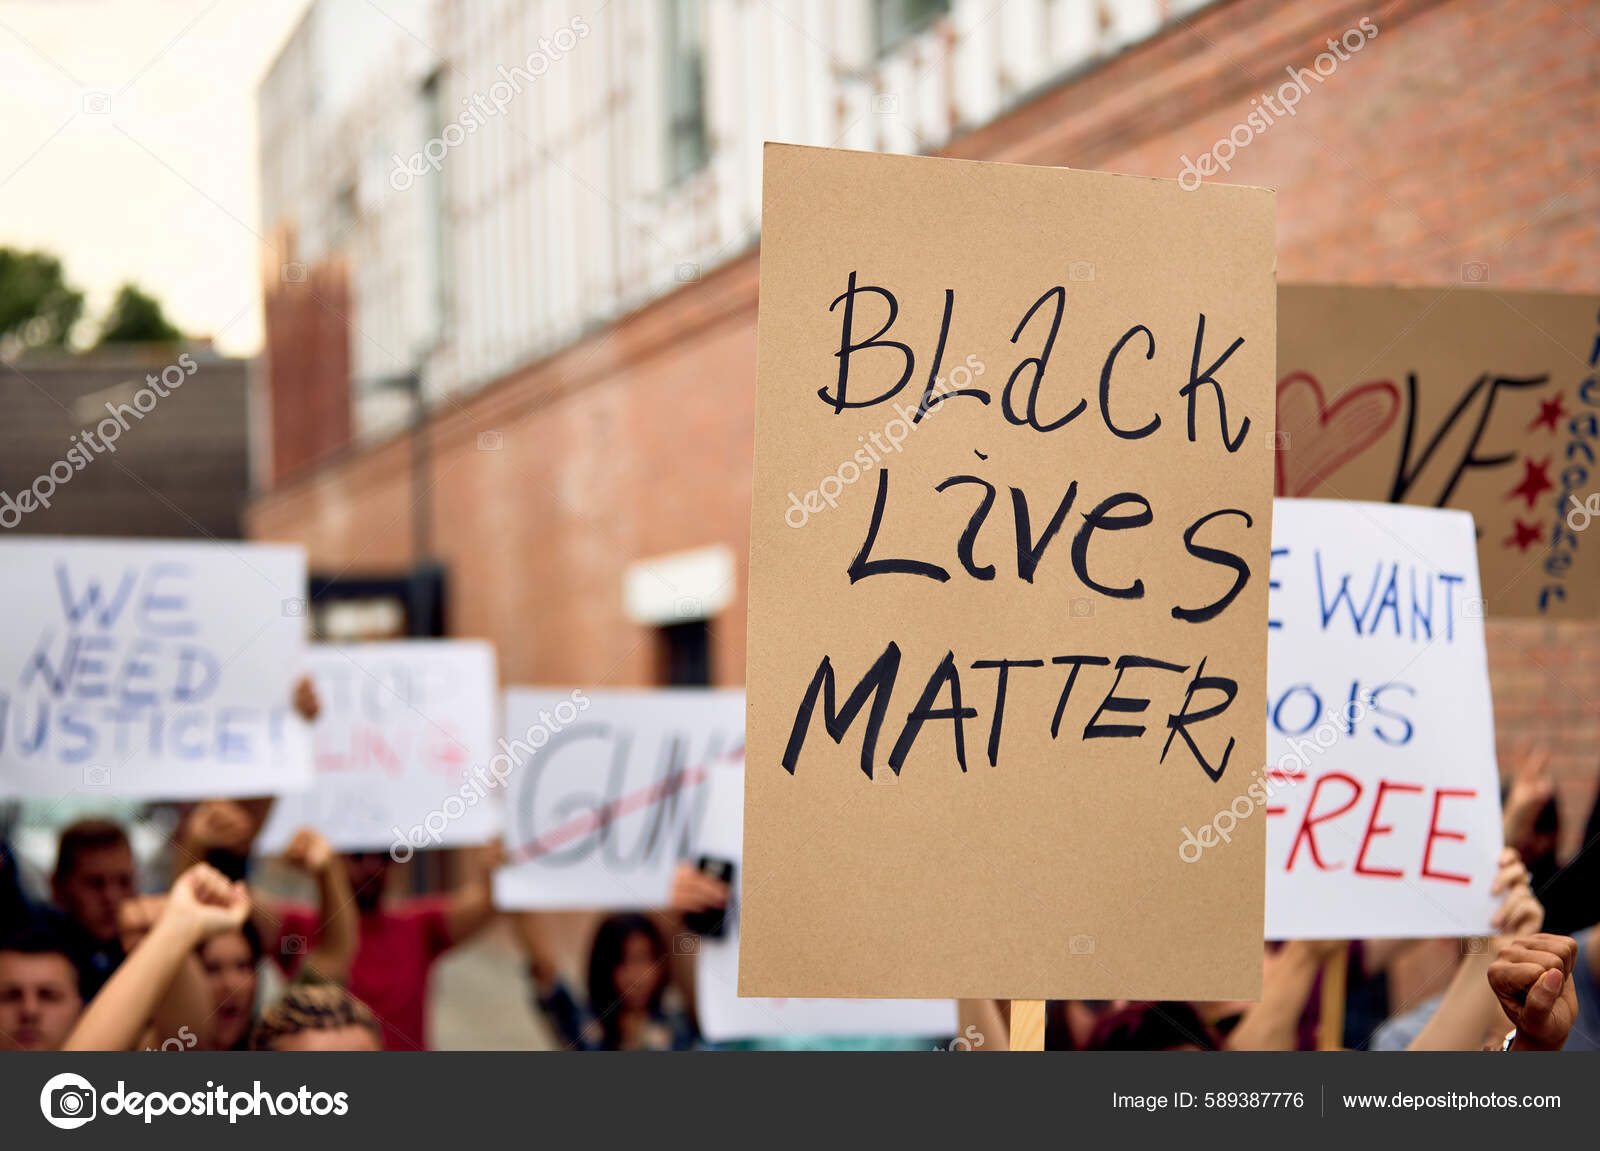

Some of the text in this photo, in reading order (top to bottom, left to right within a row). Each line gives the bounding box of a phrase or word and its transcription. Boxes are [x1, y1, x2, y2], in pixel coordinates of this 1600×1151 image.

[55, 561, 200, 637] WE
[1314, 548, 1465, 642] WANT
[17, 628, 222, 706] NEED
[781, 640, 1240, 783] MATTER
